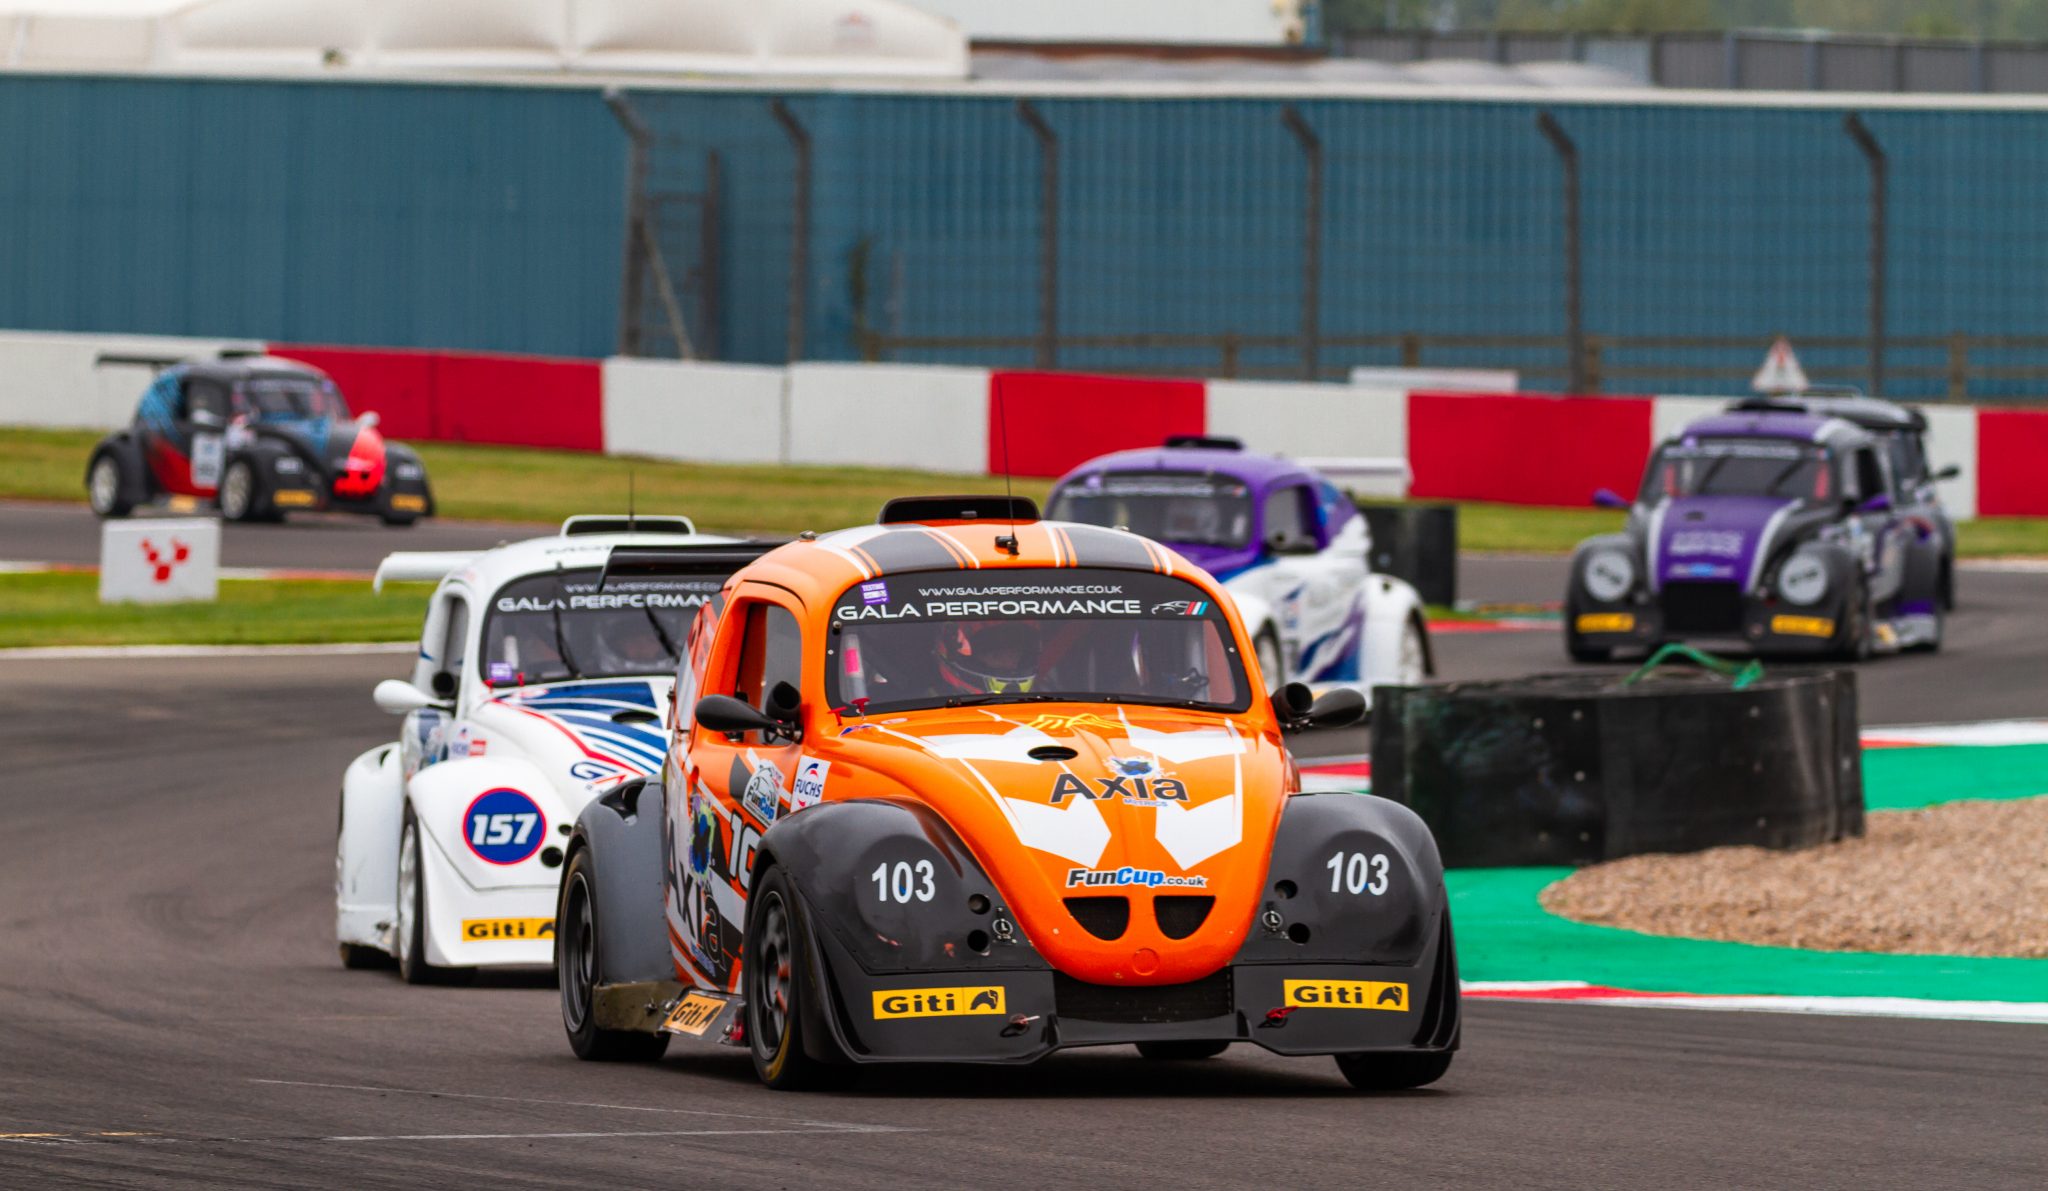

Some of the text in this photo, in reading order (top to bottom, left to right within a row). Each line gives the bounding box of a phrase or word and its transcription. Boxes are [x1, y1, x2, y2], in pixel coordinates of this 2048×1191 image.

[918, 585, 1122, 597] WWW.GALAPERFORMANCE.CO.UK
[837, 600, 1141, 620] GALA PERFORMANCE
[795, 778, 822, 798] FUCHS
[472, 813, 538, 845] 157
[872, 859, 936, 904] 103
[1068, 867, 1205, 887] FunCup.co.uk
[1327, 851, 1390, 896] 103
[468, 922, 526, 938] Giti
[881, 993, 955, 1014] Giti
[1293, 985, 1363, 1004] Giti
[671, 1001, 708, 1027] Giti
